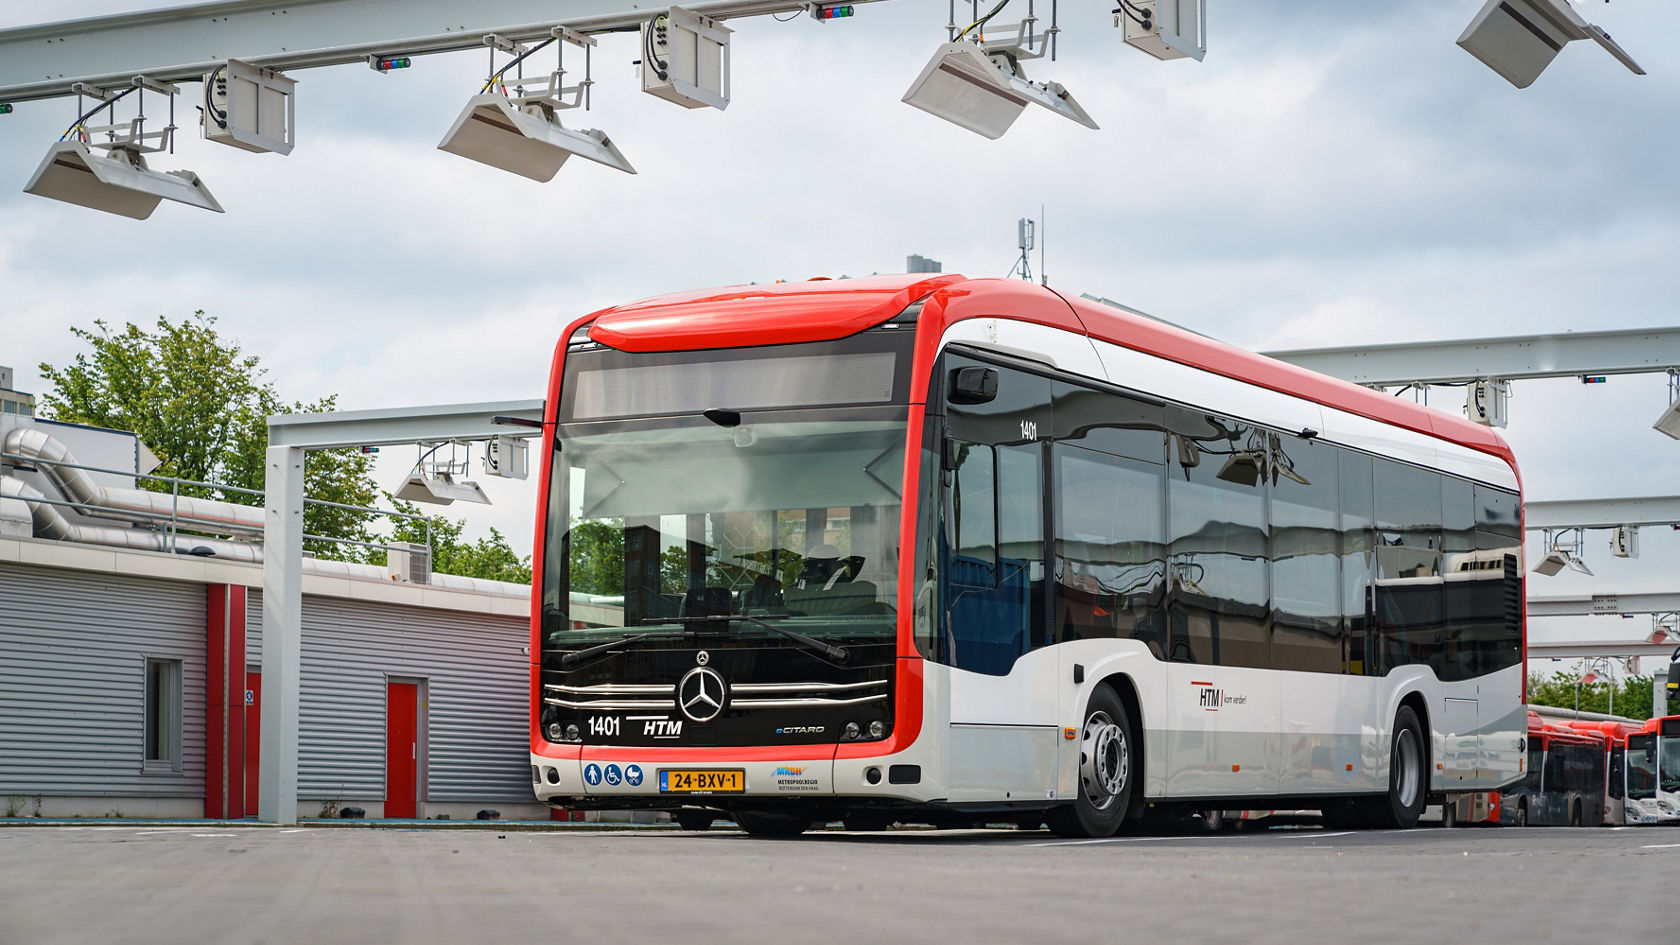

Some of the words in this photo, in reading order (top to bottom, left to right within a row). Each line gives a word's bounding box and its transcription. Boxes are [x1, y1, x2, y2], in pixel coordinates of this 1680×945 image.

[1020, 420, 1037, 441] 1401
[1200, 688, 1220, 707] HTM
[588, 716, 620, 736] 1401
[643, 721, 683, 736] HTM
[675, 773, 736, 788] 24-BXV-1
